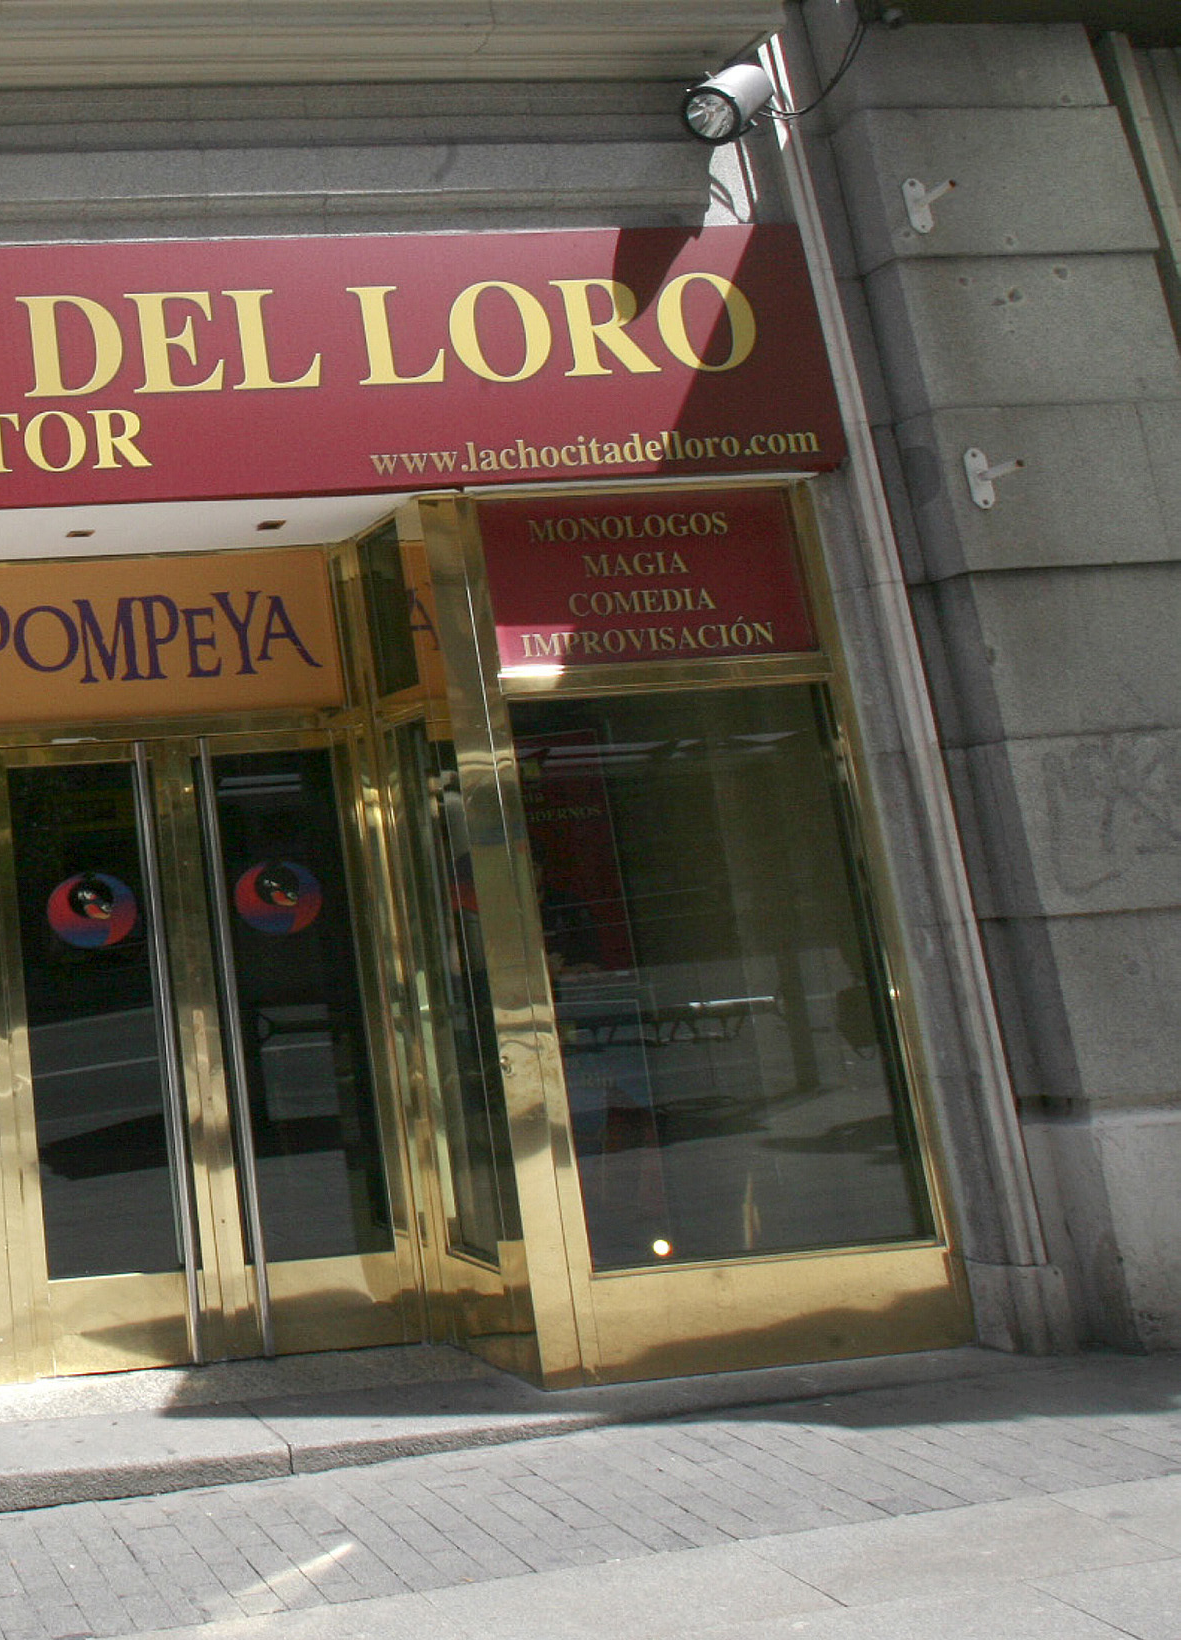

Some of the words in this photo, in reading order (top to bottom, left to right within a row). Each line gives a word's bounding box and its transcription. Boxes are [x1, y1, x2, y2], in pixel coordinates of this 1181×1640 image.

[15, 288, 322, 398] DEL
[346, 271, 757, 386] LORO
[370, 430, 820, 477] www.lachocitadelloro.com
[527, 511, 729, 544] MONOLOGOS
[582, 551, 690, 578] MAGIA
[569, 587, 717, 618] COMEDIA
[521, 615, 775, 658] IMPROVISACIÓN
